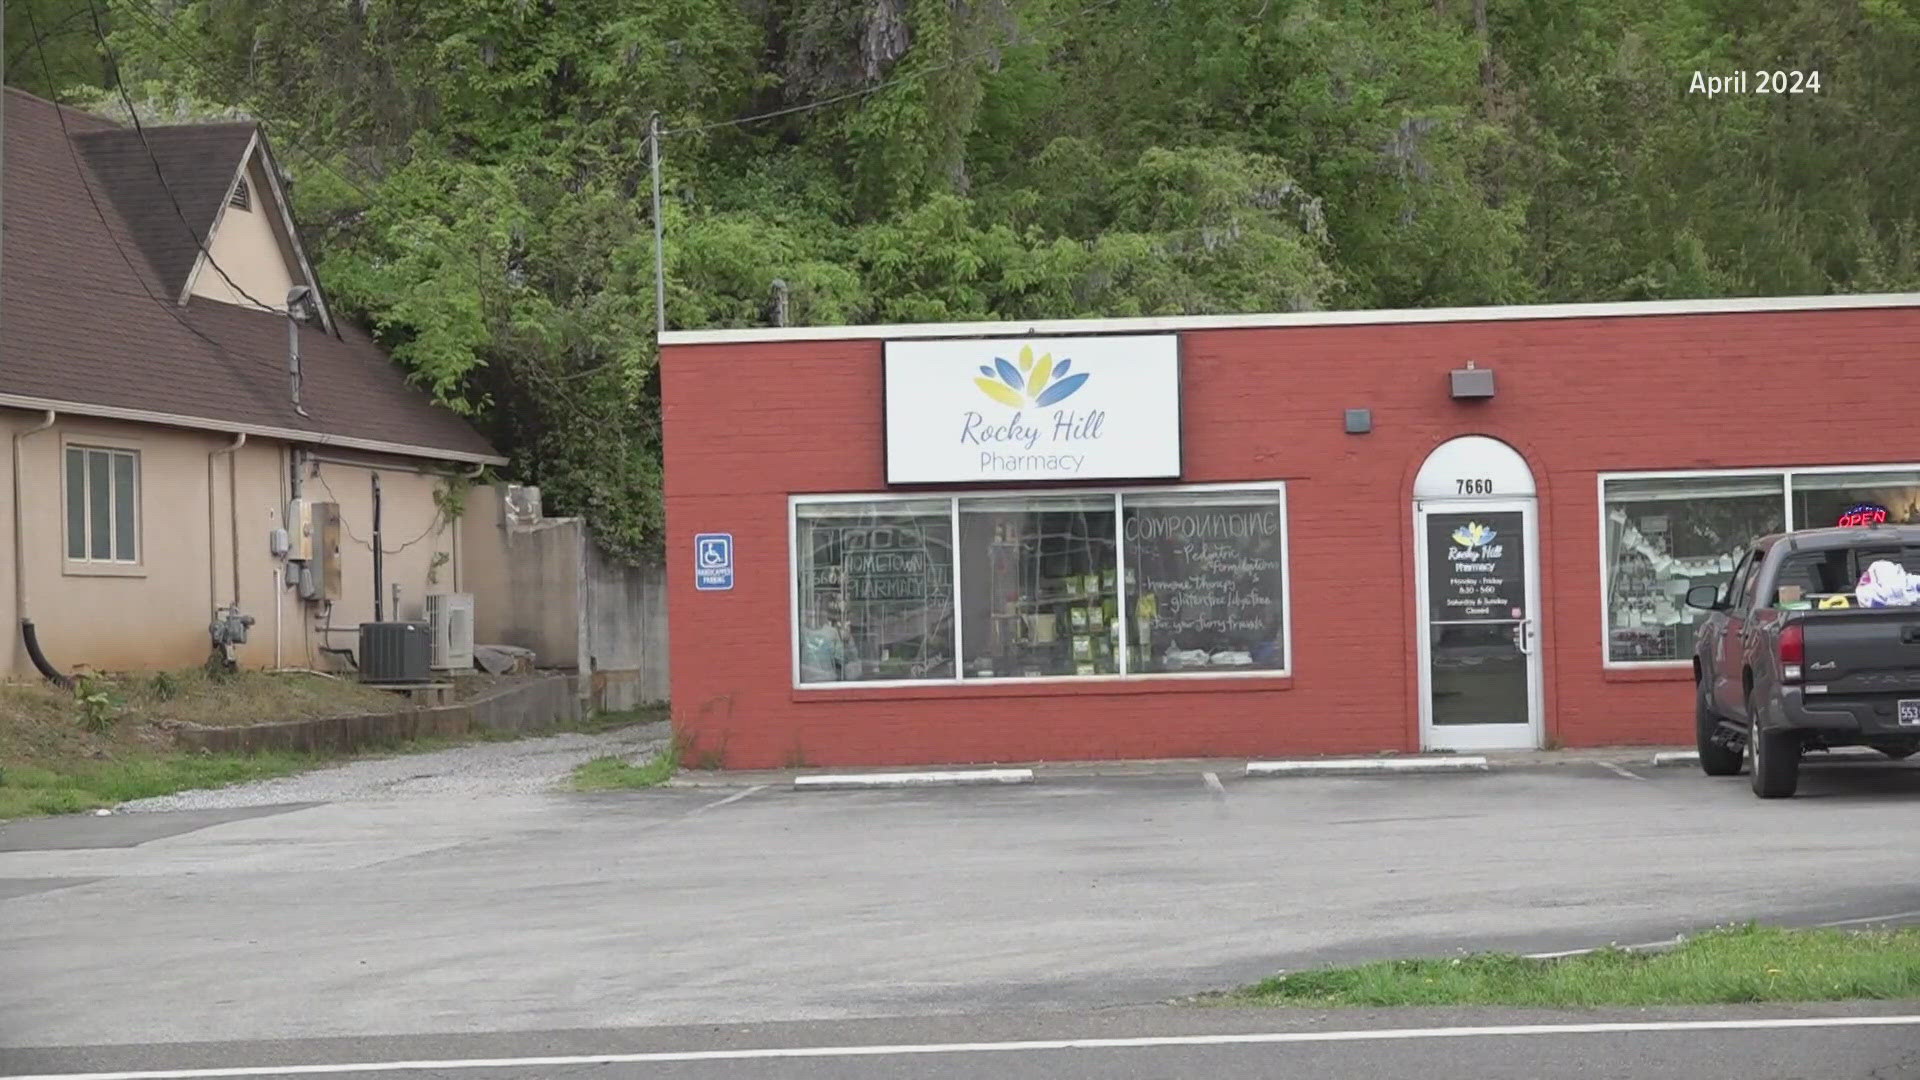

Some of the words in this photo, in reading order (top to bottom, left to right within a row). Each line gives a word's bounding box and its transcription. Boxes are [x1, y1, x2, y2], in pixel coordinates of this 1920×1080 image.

[960, 409, 1041, 449] Rocky
[1052, 408, 1105, 441] Hill
[980, 451, 1085, 472] Pharmacy
[1456, 479, 1493, 495] 7660
[1125, 511, 1279, 541] COMPOUNDING
[1838, 511, 1887, 528] OPEN
[1448, 546, 1480, 562] Rocky
[1481, 544, 1503, 560] Hill
